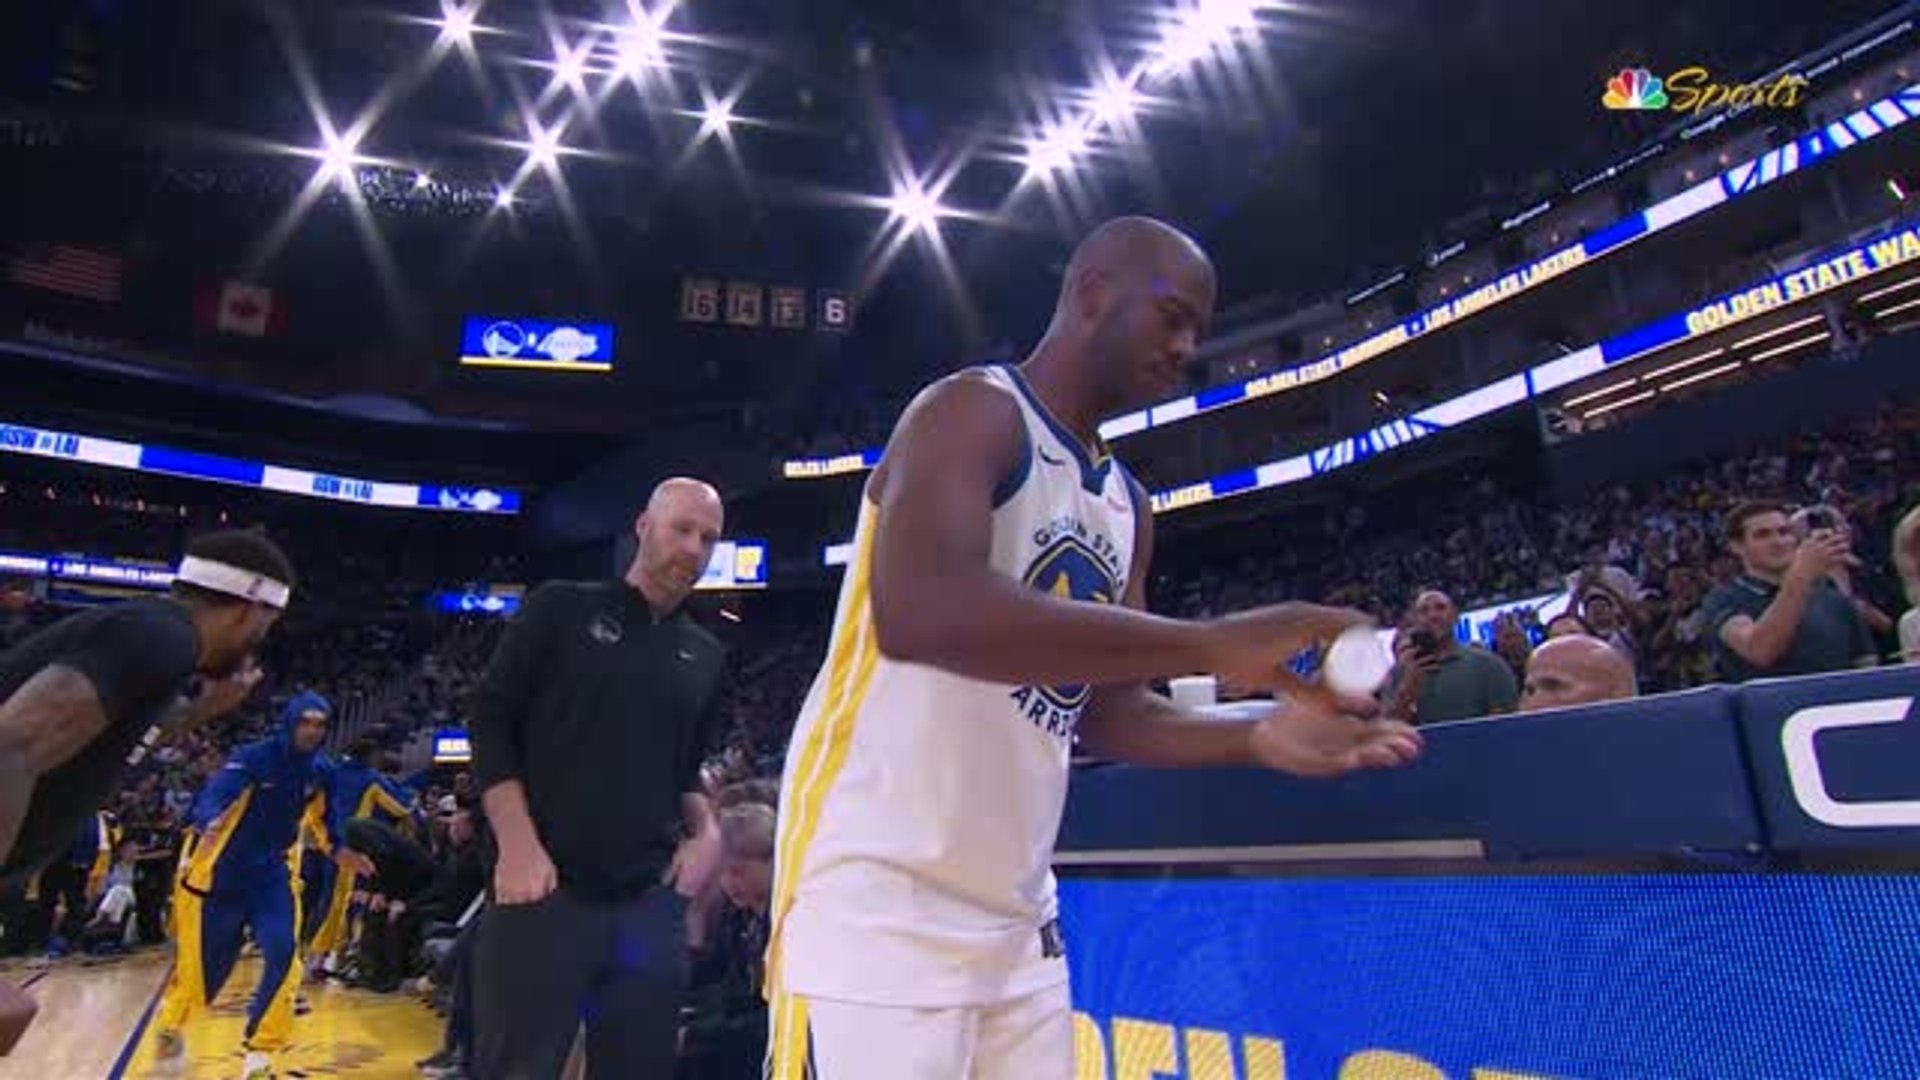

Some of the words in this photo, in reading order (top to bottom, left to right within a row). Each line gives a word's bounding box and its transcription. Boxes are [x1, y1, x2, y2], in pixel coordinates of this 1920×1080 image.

[1686, 281, 1785, 336] GOLDEN
[1784, 250, 1868, 299] STATE
[1781, 696, 1920, 826] C
